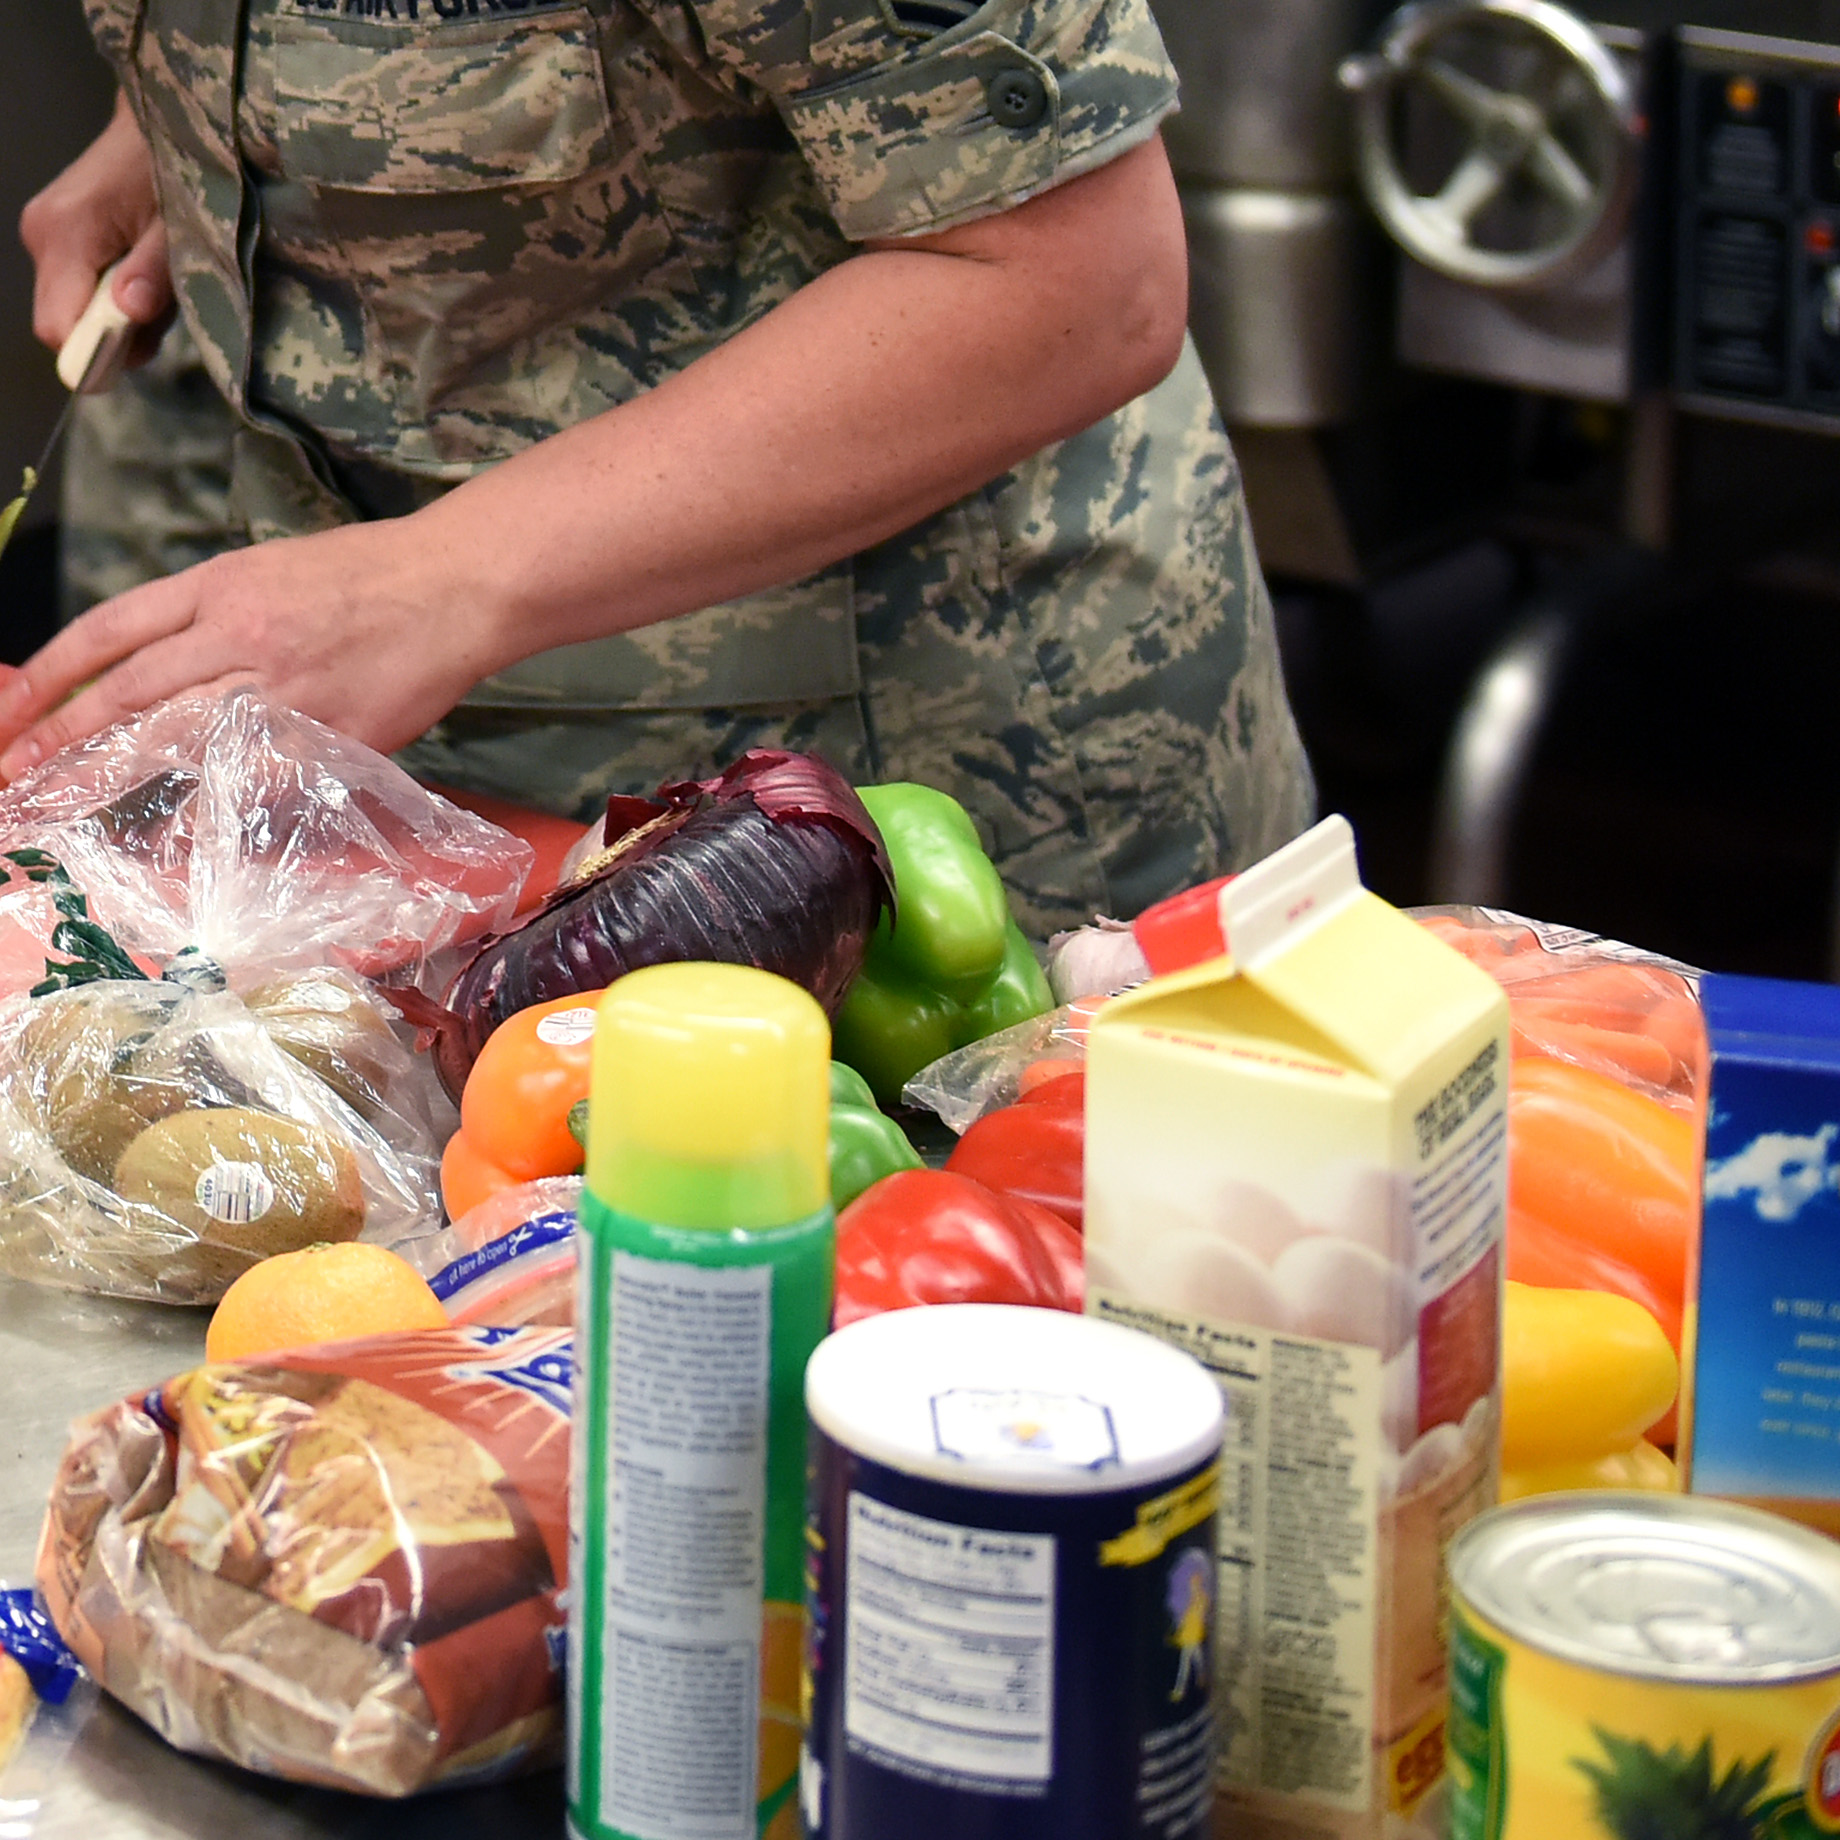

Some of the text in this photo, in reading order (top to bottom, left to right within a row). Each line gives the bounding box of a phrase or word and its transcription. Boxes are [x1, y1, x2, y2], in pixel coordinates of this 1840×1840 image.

[1099, 1299, 1257, 1349] Nutrition Facts
[858, 1506, 1034, 1558] Nutrition Facts
